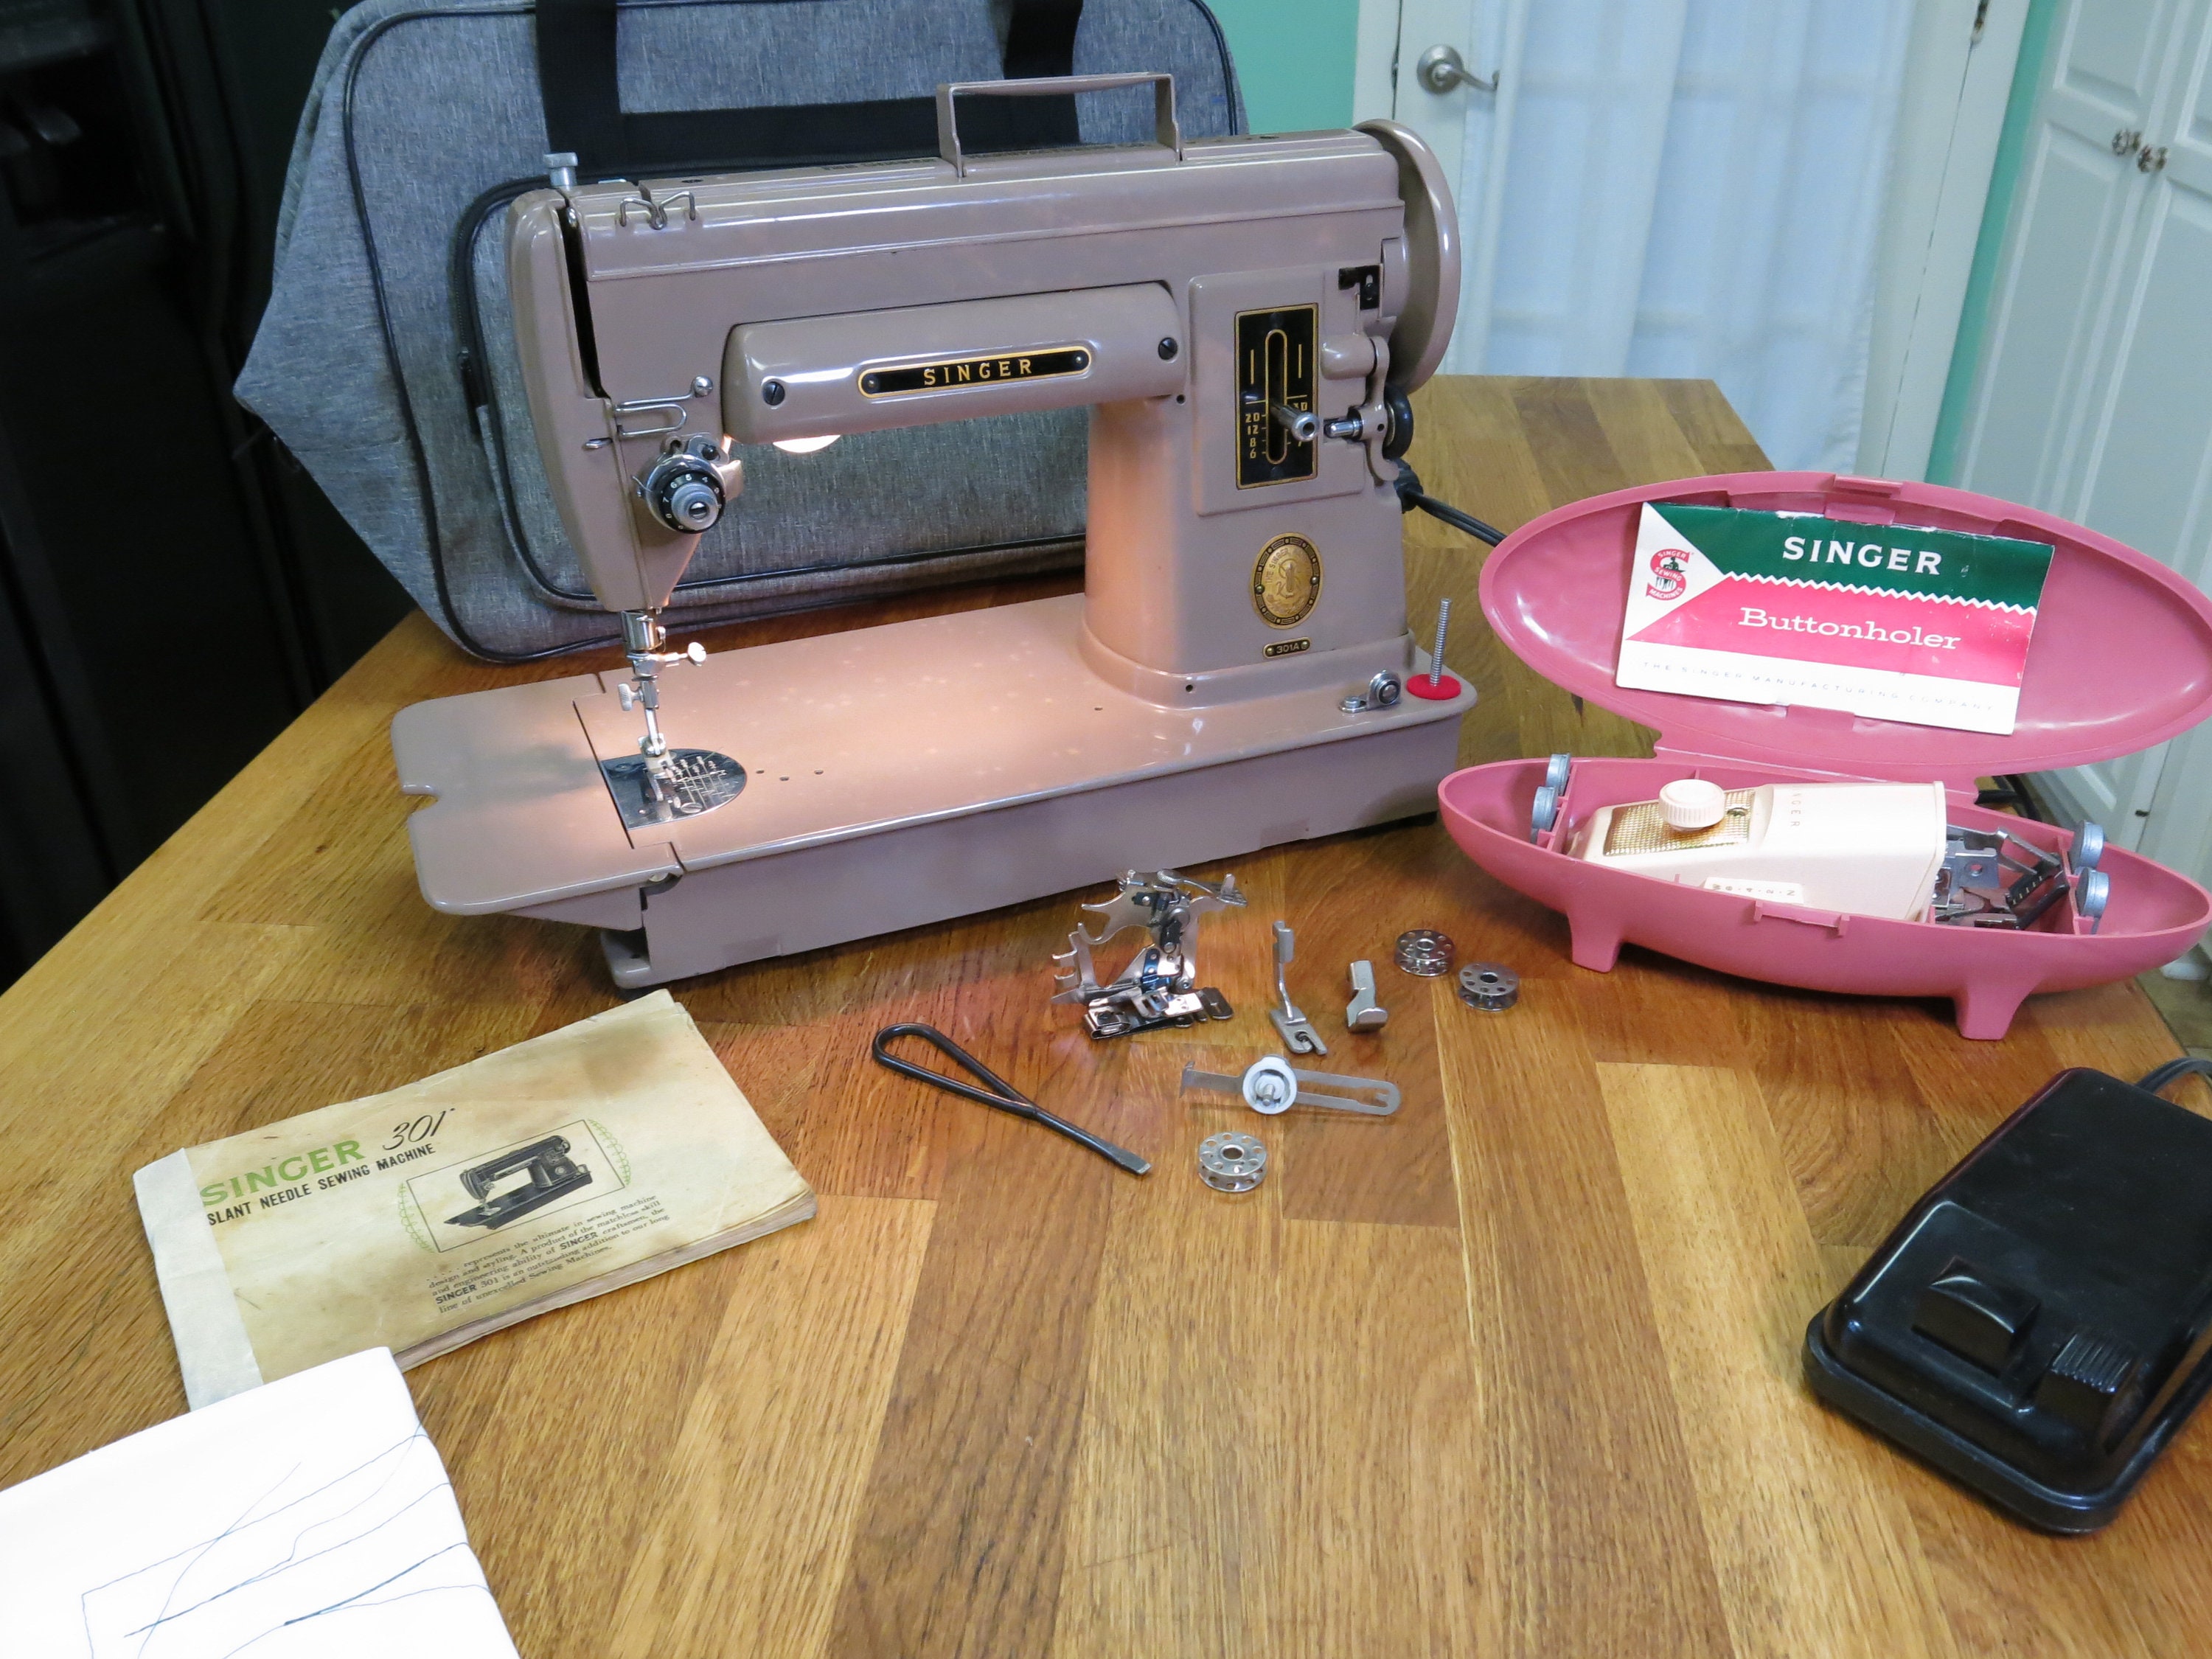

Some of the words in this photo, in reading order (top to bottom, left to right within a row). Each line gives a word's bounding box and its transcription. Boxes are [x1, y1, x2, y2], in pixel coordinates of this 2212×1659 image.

[923, 358, 1032, 386] SINGER
[1245, 412, 1260, 422] 20
[1247, 425, 1259, 435] 12
[1249, 448, 1256, 459] 6
[1250, 437, 1256, 448] 8
[1655, 566, 1683, 582] SEWING
[1658, 550, 1686, 559] SINGER
[1782, 536, 1943, 576] SINGER
[1649, 587, 1683, 599] MACHINES
[1276, 643, 1300, 654] 301A
[1738, 607, 1961, 650] Buttonholer
[1644, 662, 1670, 671] THE
[1682, 667, 1742, 678] SINGER
[1753, 675, 1899, 699] MANUFACTURING
[1910, 695, 1993, 710] COMPANY
[200, 1140, 366, 1208] SINGER
[207, 1202, 252, 1226] SLANT
[260, 1183, 313, 1210] NEEDLE
[318, 1164, 371, 1190] SEWING
[376, 1143, 436, 1172] MACHINE
[429, 1274, 459, 1288] design
[462, 1265, 480, 1276] and
[531, 1235, 566, 1253] product
[568, 1229, 577, 1238] of
[580, 1225, 594, 1234] the
[597, 1210, 639, 1228] matchless
[641, 1200, 661, 1211] skill
[464, 1248, 510, 1267] represents
[514, 1240, 529, 1249] the
[532, 1226, 569, 1242] ultimate
[586, 1209, 616, 1222] sewing
[620, 1195, 656, 1211] machine
[433, 1284, 450, 1296] and
[453, 1266, 509, 1288] engineering
[512, 1253, 542, 1268] ability
[546, 1246, 555, 1255] of
[560, 1231, 599, 1250] SINGER
[651, 1208, 665, 1216] the
[436, 1284, 477, 1304] SINGER
[480, 1277, 498, 1288] 301
[527, 1250, 580, 1272] outstanding
[582, 1234, 619, 1251] addition
[633, 1223, 648, 1231] our
[649, 1214, 670, 1225] long
[439, 1304, 458, 1313] line
[462, 1295, 472, 1305] of
[476, 1277, 526, 1300] unexcelled
[529, 1264, 564, 1280] Sewing
